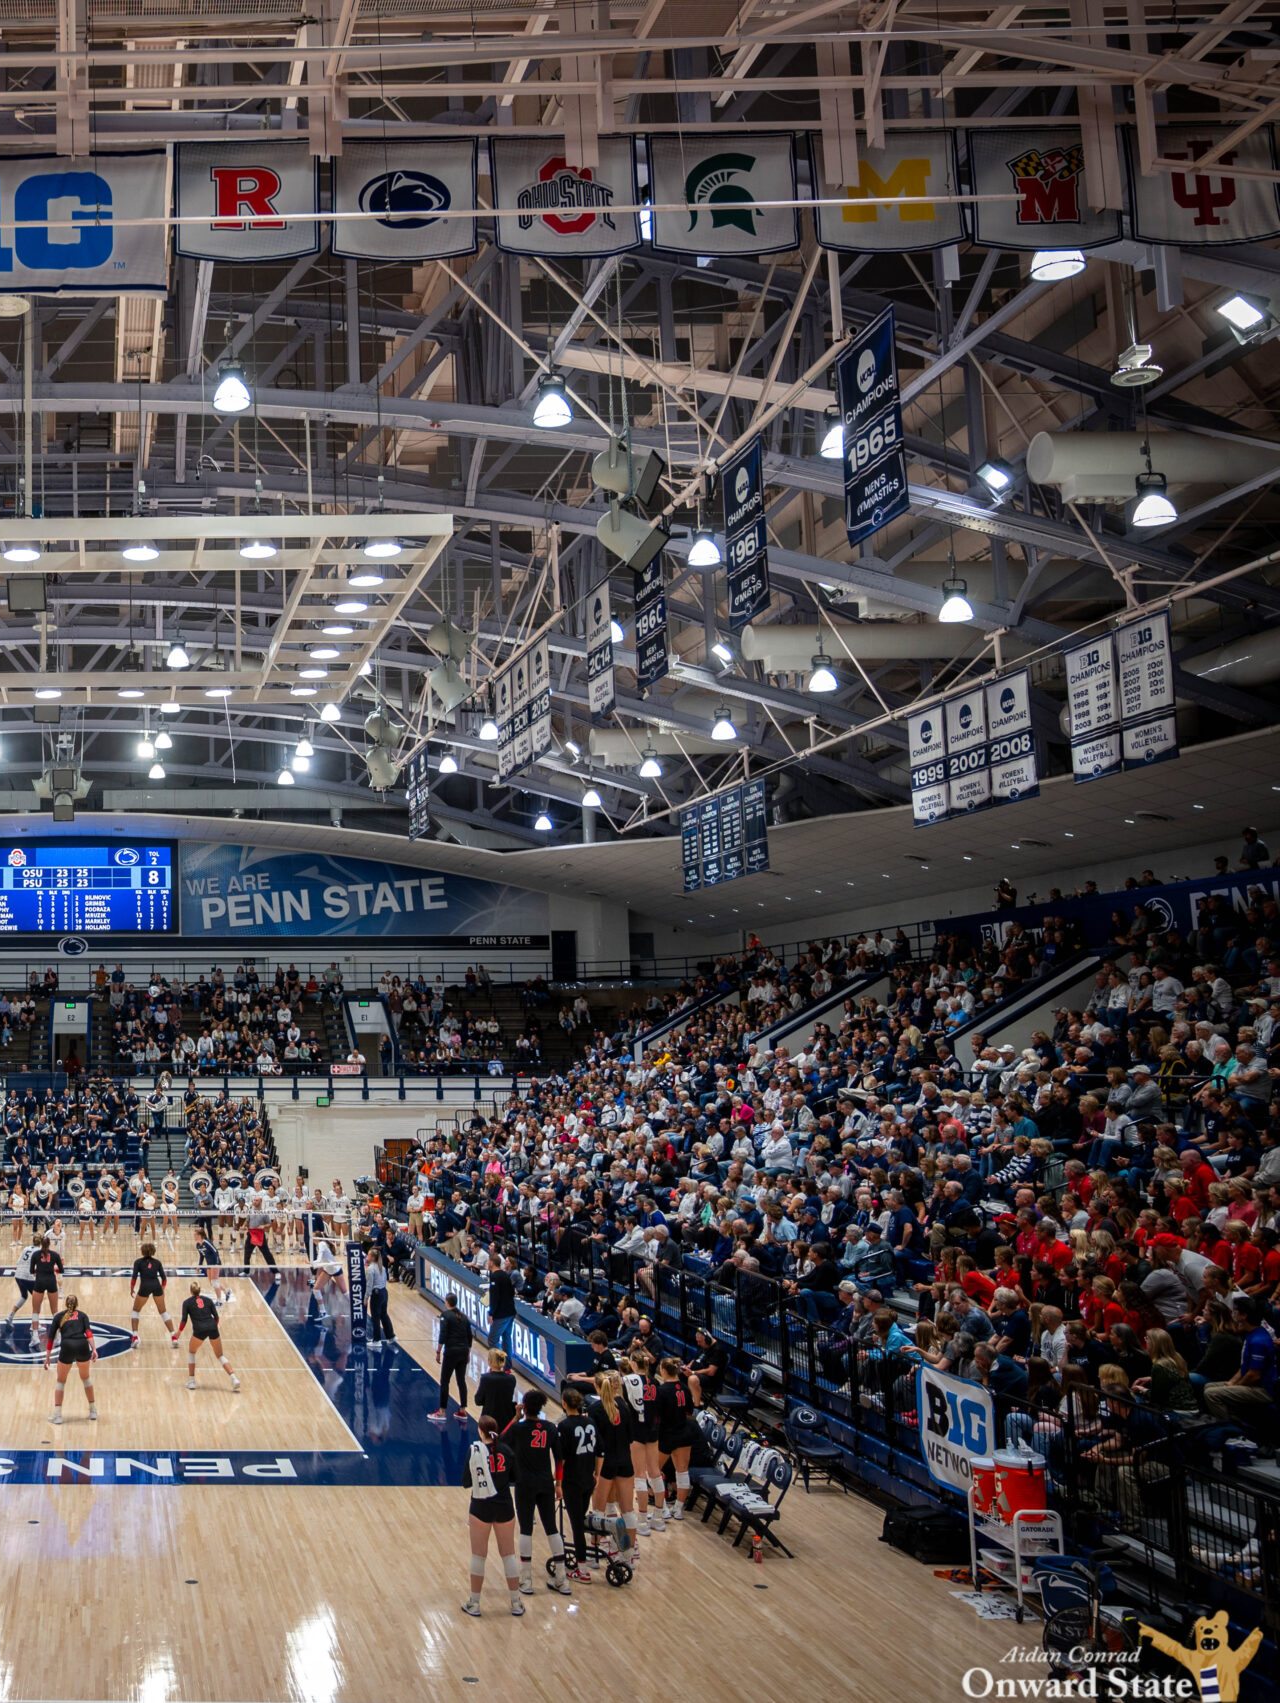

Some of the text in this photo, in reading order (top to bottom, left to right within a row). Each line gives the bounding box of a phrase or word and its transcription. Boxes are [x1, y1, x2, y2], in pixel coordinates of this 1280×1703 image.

[211, 165, 286, 231] R
[842, 159, 937, 223] M
[1017, 175, 1080, 225] M
[845, 374, 894, 425] CHAMPIONS
[848, 414, 896, 473] 1965
[856, 478, 899, 518] GYMNASTICS
[727, 492, 761, 527] CHAMPIONS
[730, 532, 759, 567] 1961
[1120, 640, 1165, 664] CHAMPIONS
[1070, 660, 1111, 686] CHAMPIONS
[1123, 667, 1140, 680] 2005
[1123, 677, 1140, 689] 2007
[1124, 685, 1141, 698] 2009
[1073, 688, 1089, 701] 1992
[1126, 694, 1141, 706] 2012
[1127, 702, 1142, 714] 2017
[991, 709, 1027, 730] CHAMPIONS
[1074, 719, 1092, 731] 2003
[950, 724, 984, 744] CHAMPIONS
[1130, 732, 1169, 750] VOLLEYBALL
[1134, 725, 1163, 740] WOMEN'S
[990, 734, 1031, 762] 2008
[1078, 748, 1114, 766] VOLLEYBALL
[949, 748, 985, 775] 2007
[912, 763, 944, 787] 1999
[956, 787, 985, 802] VOLLEYBALL
[151, 857, 157, 865] 2
[22, 869, 88, 877] OSU 23 25
[148, 870, 159, 885] 8
[23, 879, 88, 888] PSU 25 23
[185, 872, 271, 895] WE ARE
[201, 877, 449, 930] PENN STATE
[469, 937, 531, 945] PENN STATE
[67, 1014, 75, 1022] E2
[23, 1251, 31, 1260] 5
[350, 1249, 363, 1321] PENN STATE
[430, 1266, 449, 1300] PENN
[450, 1279, 477, 1323] STATE
[196, 1297, 205, 1309] 9
[643, 1384, 656, 1401] 20
[676, 1391, 686, 1406] 11
[531, 1430, 547, 1448] 21
[575, 1424, 596, 1454] 23
[46, 1456, 298, 1478] PENN
[488, 1454, 505, 1473] 12
[927, 1440, 973, 1478] NETWO
